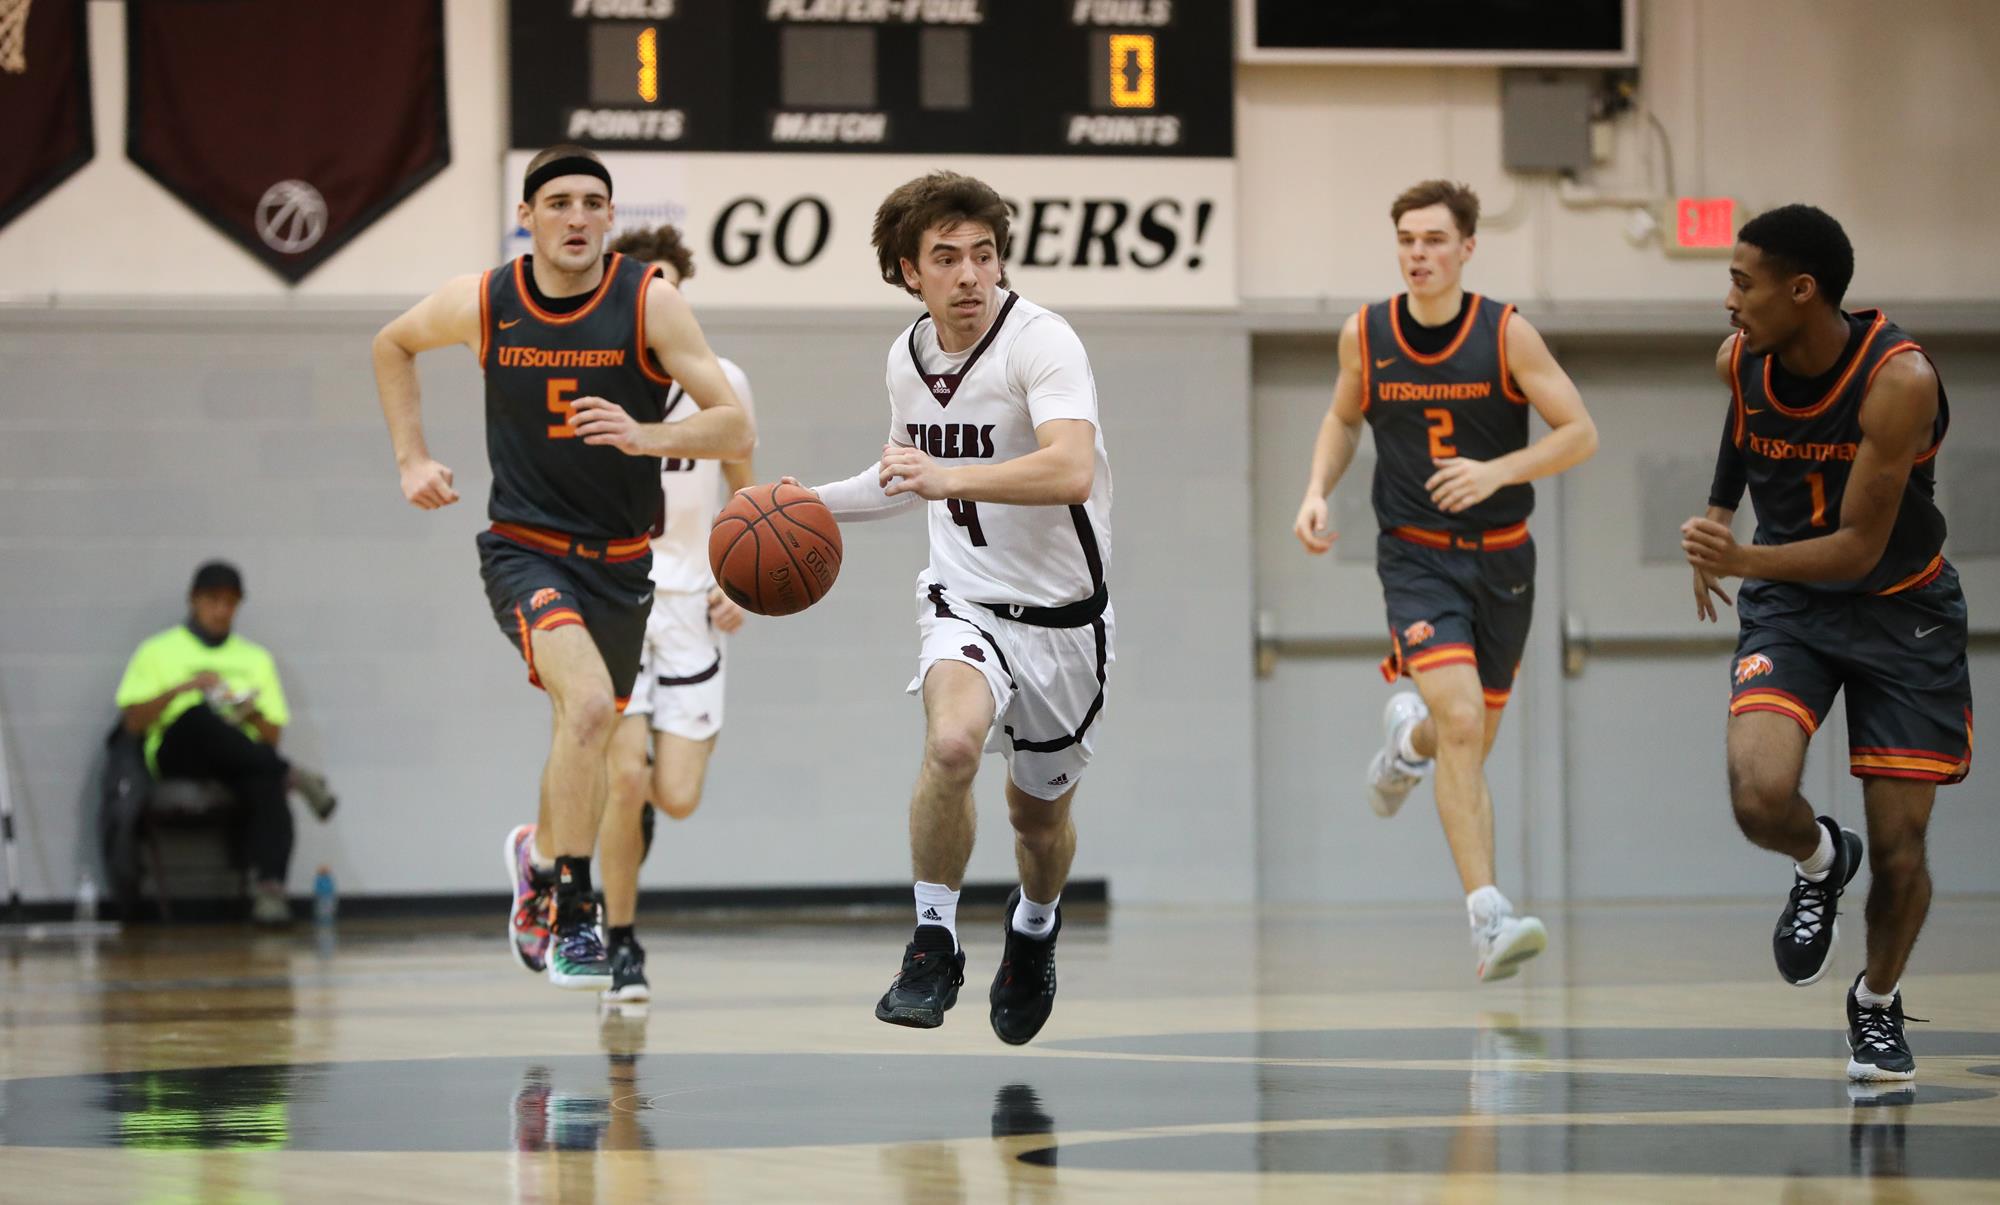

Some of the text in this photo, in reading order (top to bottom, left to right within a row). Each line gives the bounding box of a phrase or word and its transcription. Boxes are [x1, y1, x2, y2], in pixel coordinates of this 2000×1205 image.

[571, 0, 675, 18] FOULS
[1072, 0, 1172, 26] FOULS
[636, 27, 657, 103] 1
[1109, 34, 1155, 108] 0
[567, 109, 685, 141] POINTS
[772, 112, 888, 142] MATCH
[1067, 115, 1181, 145] POINTS
[711, 196, 832, 268] GO
[1677, 198, 1733, 247] EXIT
[547, 378, 579, 438] 5
[906, 423, 997, 459] TIGERS
[1424, 408, 1458, 459] 2
[947, 497, 988, 547] 4
[1805, 472, 1827, 528] 1
